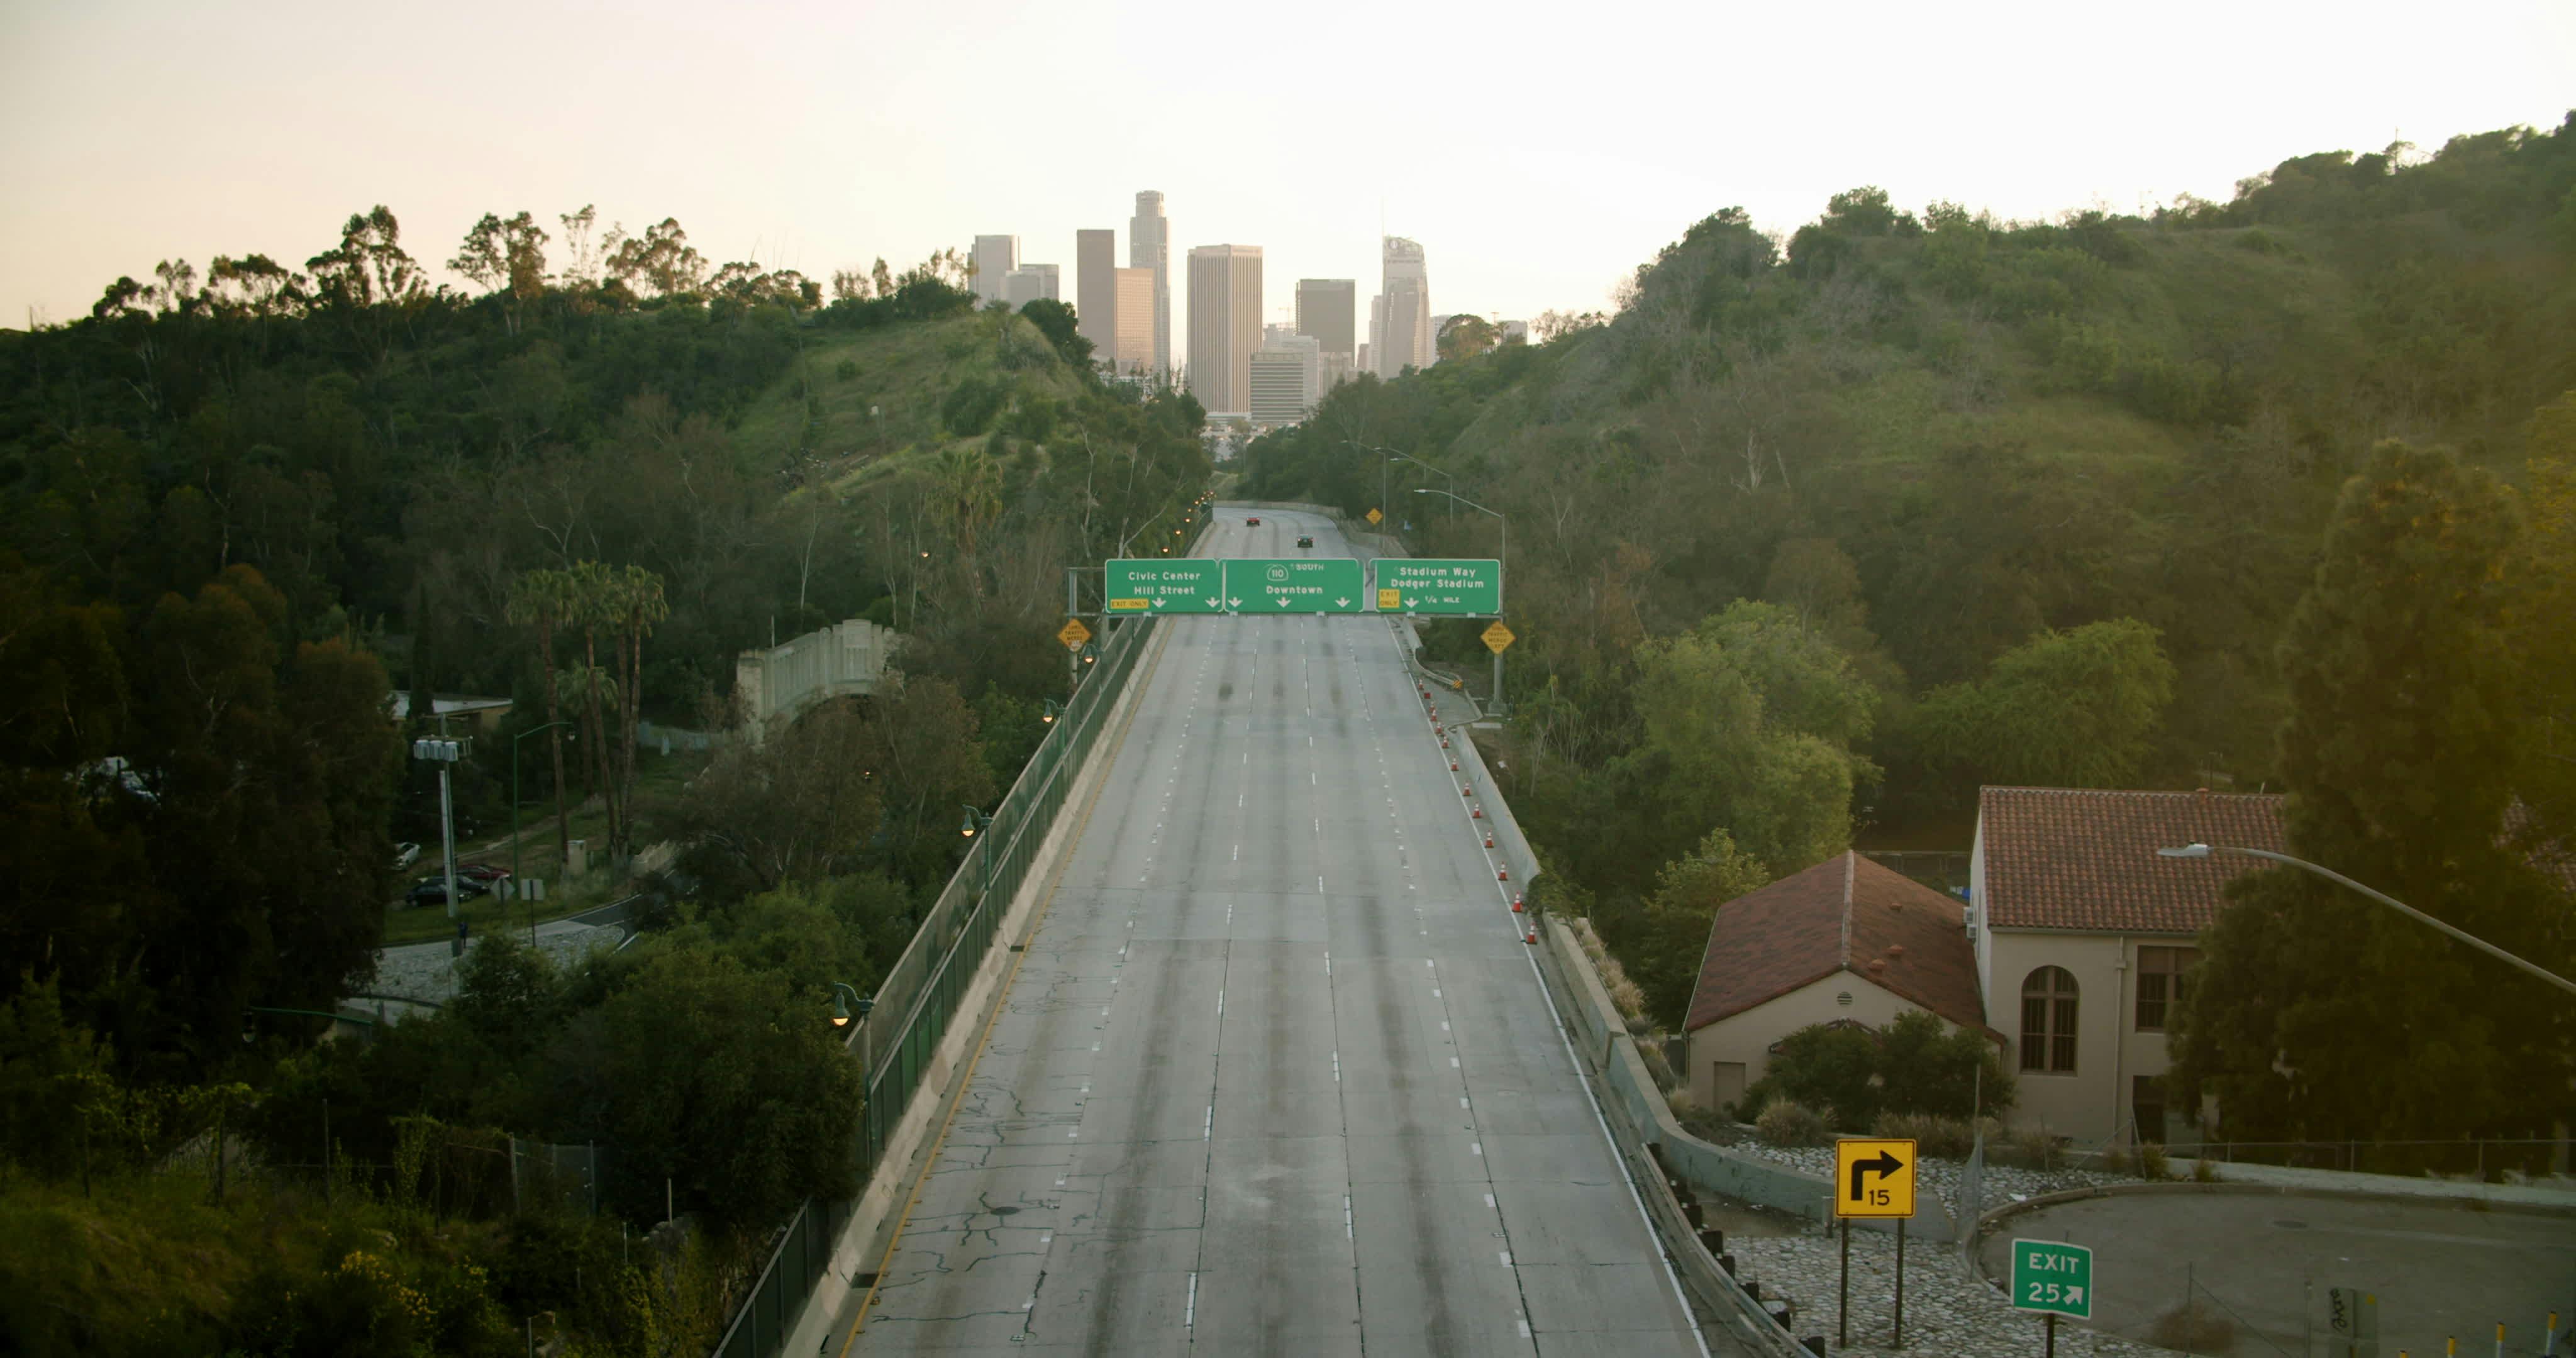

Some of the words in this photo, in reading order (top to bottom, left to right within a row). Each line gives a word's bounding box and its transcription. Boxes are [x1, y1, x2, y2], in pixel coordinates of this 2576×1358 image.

[1128, 571, 1157, 580] Civic
[1162, 571, 1201, 580] Center
[1272, 570, 1284, 578] 110
[1399, 567, 1447, 576] Stadium
[1453, 567, 1476, 578] Way
[1391, 578, 1431, 589] Dodger
[1436, 579, 1484, 588] Stadium
[1134, 586, 1155, 595] Hill
[1160, 585, 1195, 595] Street
[1266, 585, 1323, 594] Downtown
[1868, 1190, 1890, 1206] 15
[2028, 1252, 2079, 1274] EXIT
[2028, 1282, 2060, 1303] 25
